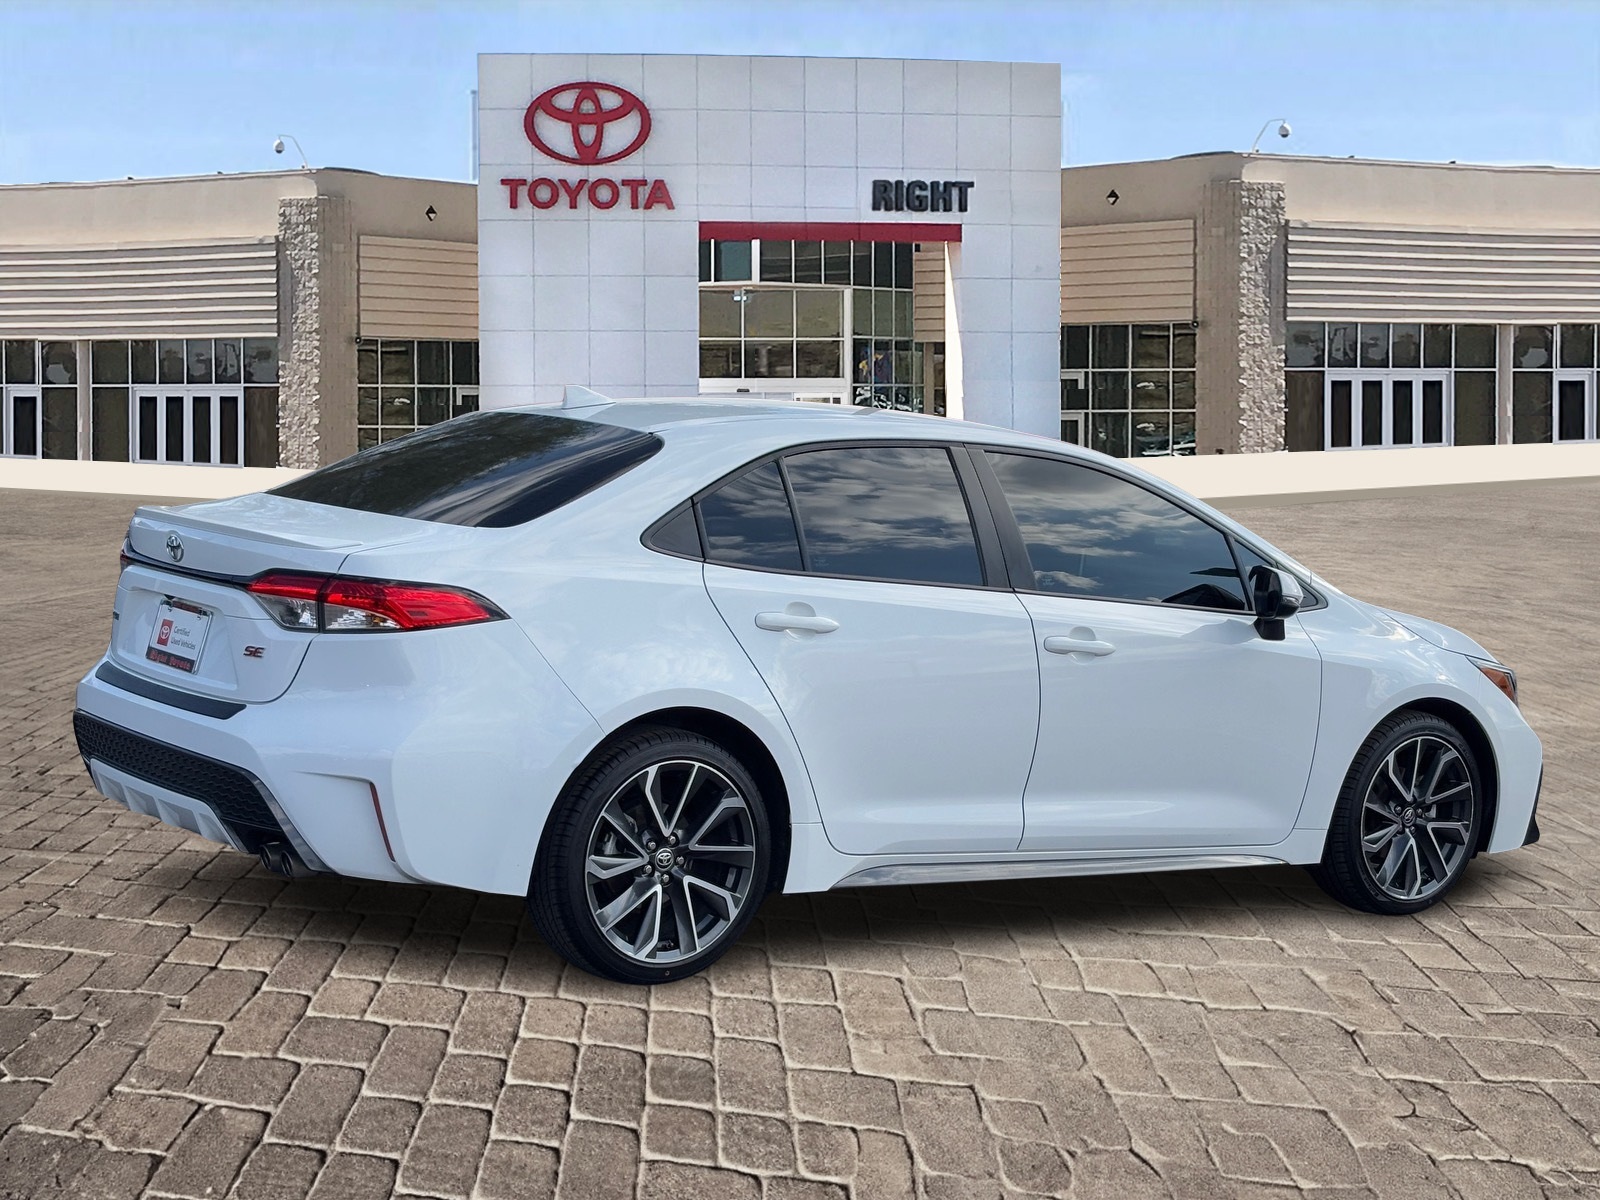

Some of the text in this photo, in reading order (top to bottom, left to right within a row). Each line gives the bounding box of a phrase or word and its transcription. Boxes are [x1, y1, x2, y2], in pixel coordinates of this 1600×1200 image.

[500, 177, 675, 209] TOYOTA
[872, 179, 975, 212] RIGHT
[173, 625, 191, 637] Certified
[170, 637, 196, 650] Used Vehicles
[243, 645, 265, 658] SE
